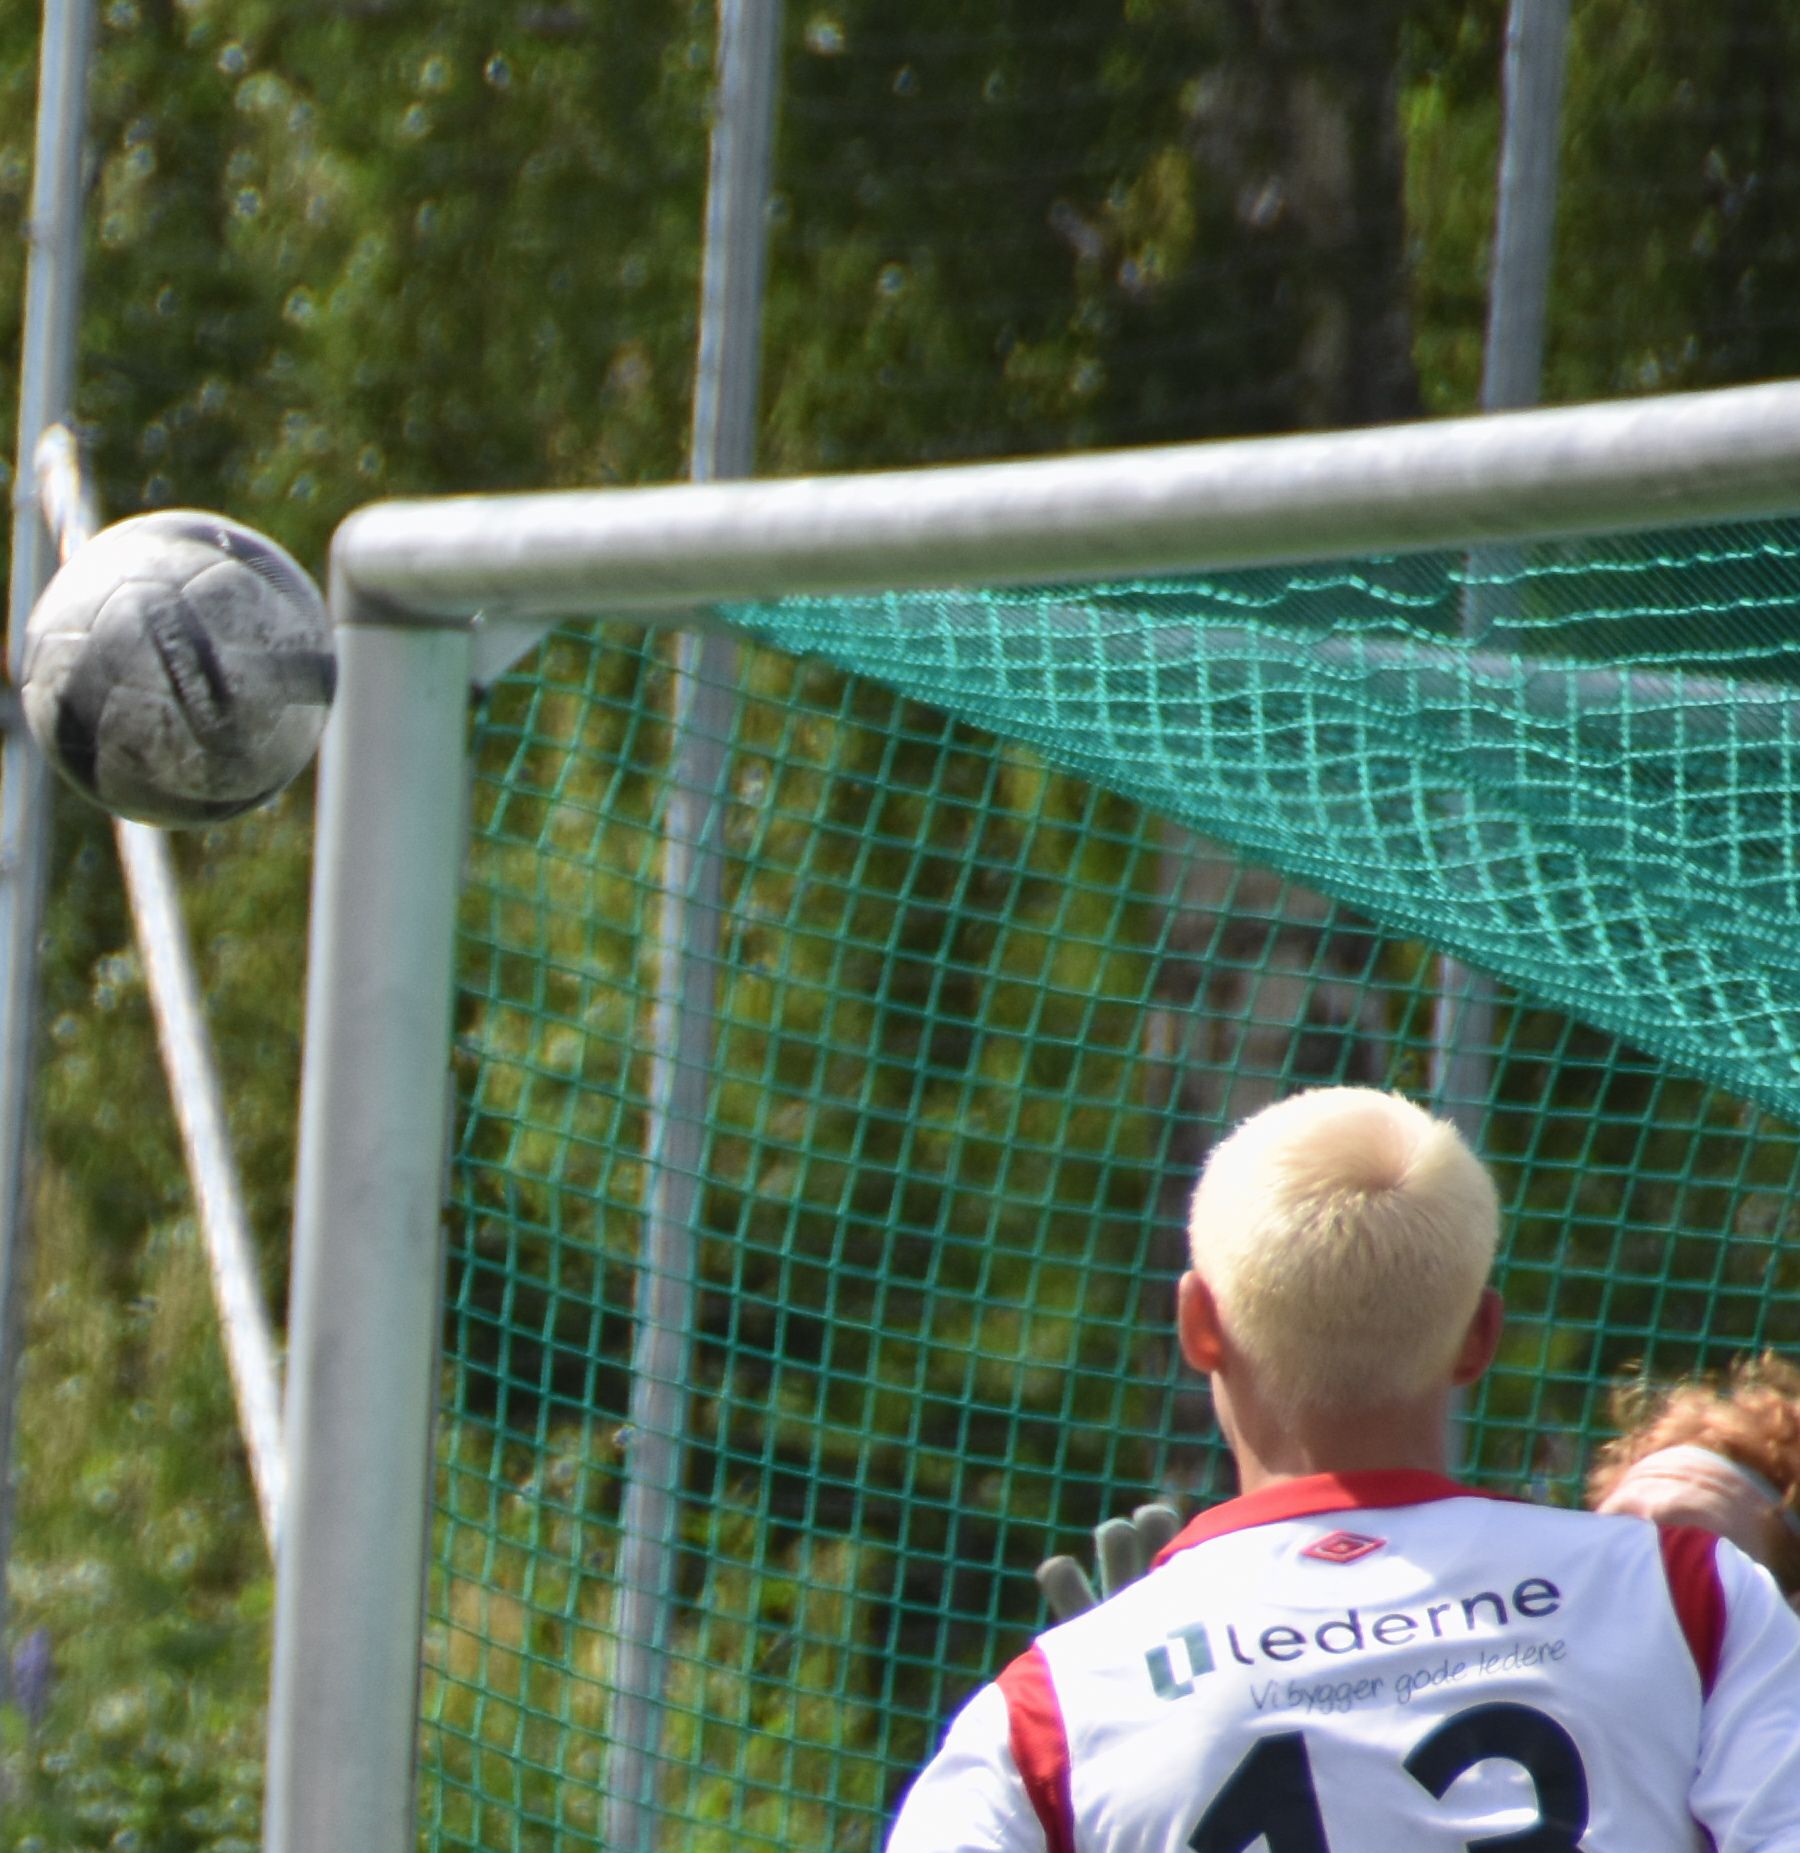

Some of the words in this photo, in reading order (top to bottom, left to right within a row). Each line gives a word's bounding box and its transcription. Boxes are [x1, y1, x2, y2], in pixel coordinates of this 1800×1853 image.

[1226, 1577, 1561, 1665] lederne
[1249, 1677, 1278, 1711] Vi
[1287, 1676, 1384, 1715] bygger
[1394, 1649, 1468, 1705] gode
[1479, 1636, 1568, 1676] ledere
